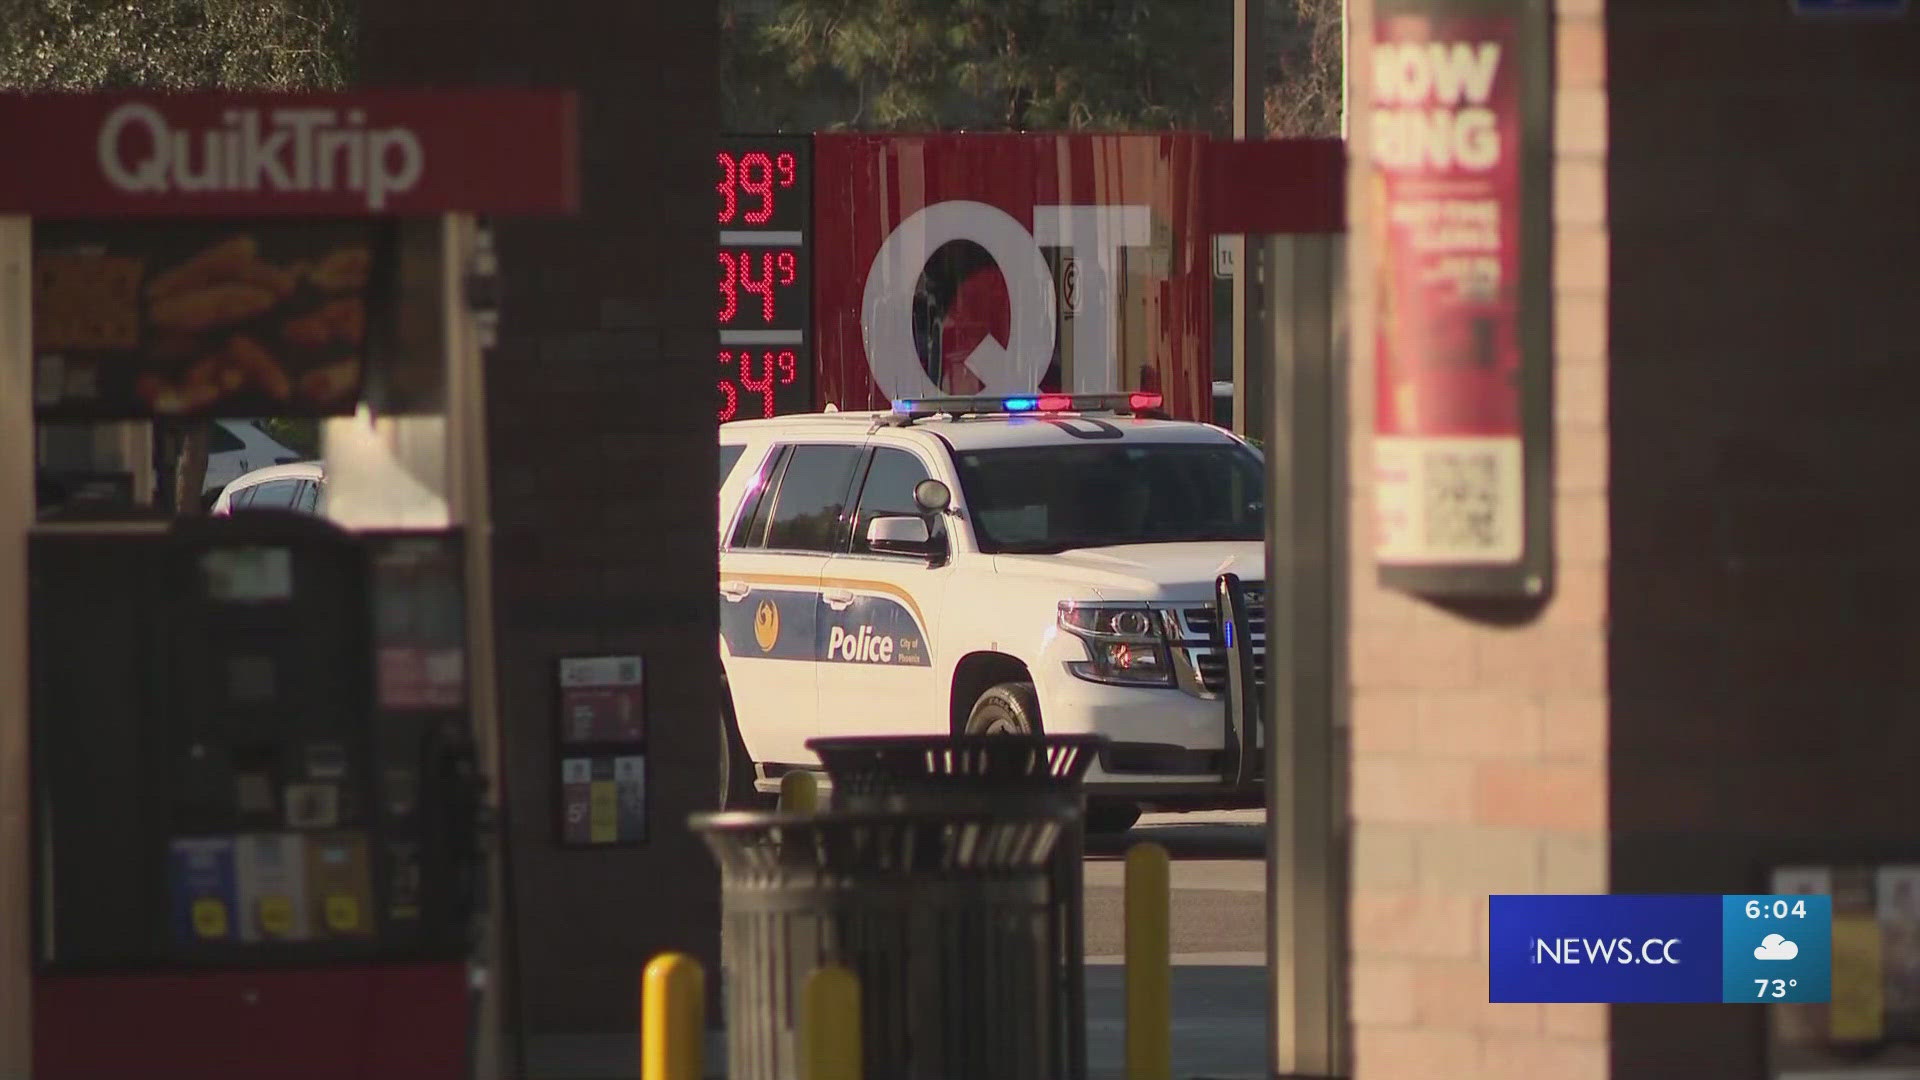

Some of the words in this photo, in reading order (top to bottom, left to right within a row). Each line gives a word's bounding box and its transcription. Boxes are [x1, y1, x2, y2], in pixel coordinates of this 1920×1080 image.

[99, 102, 424, 208] QuikTrip
[861, 199, 1151, 397] QT
[827, 625, 894, 662] Police
